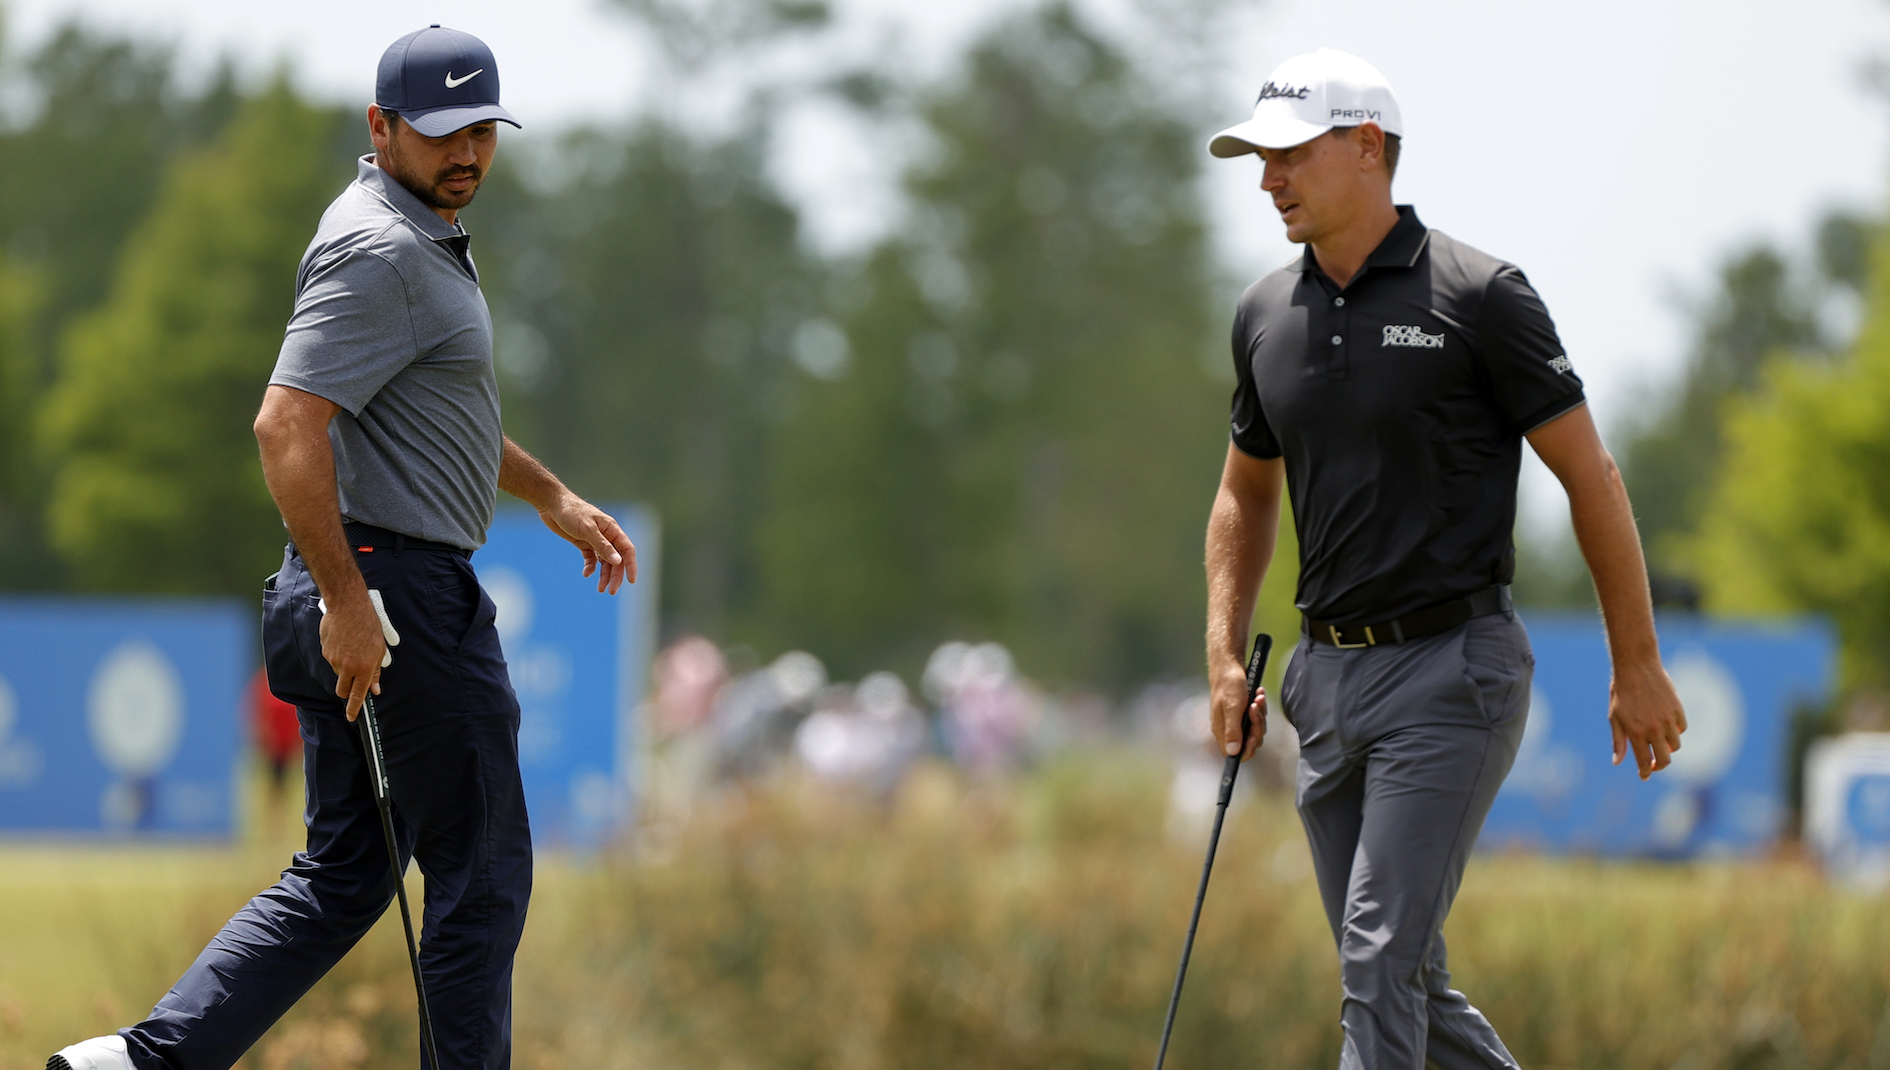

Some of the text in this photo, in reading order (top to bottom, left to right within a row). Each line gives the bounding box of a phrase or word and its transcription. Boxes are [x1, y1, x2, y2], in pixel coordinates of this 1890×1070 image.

[1255, 80, 1311, 108] leist
[1382, 325, 1422, 336] OSCAR
[1381, 335, 1445, 348] JACOBSON
[1248, 651, 1262, 692] ODYSS
